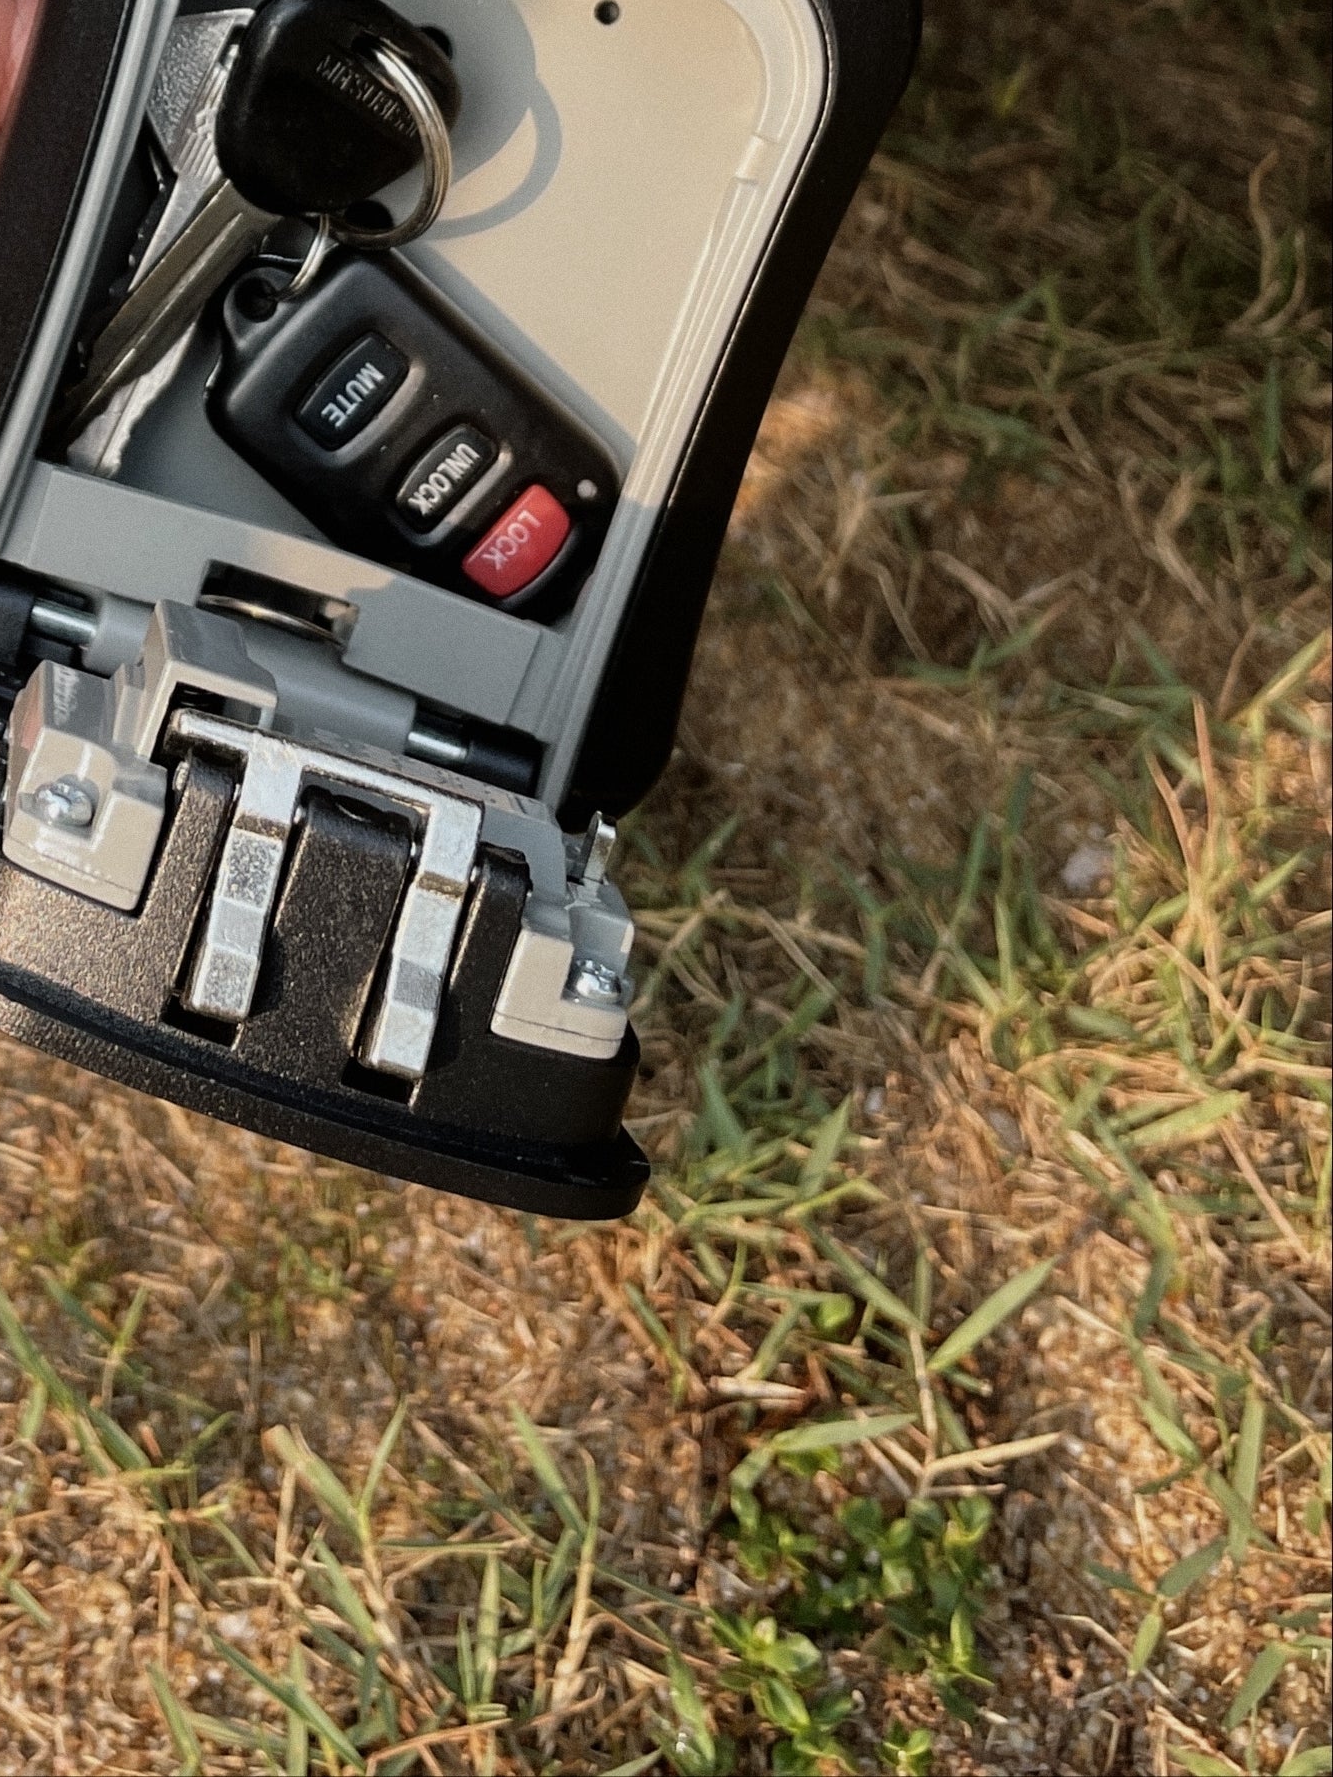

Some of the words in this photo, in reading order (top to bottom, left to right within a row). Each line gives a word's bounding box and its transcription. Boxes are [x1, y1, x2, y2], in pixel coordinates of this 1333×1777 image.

[319, 361, 386, 429] MUTE
[407, 441, 482, 518] UNLOCK
[481, 509, 542, 572] LOCK
